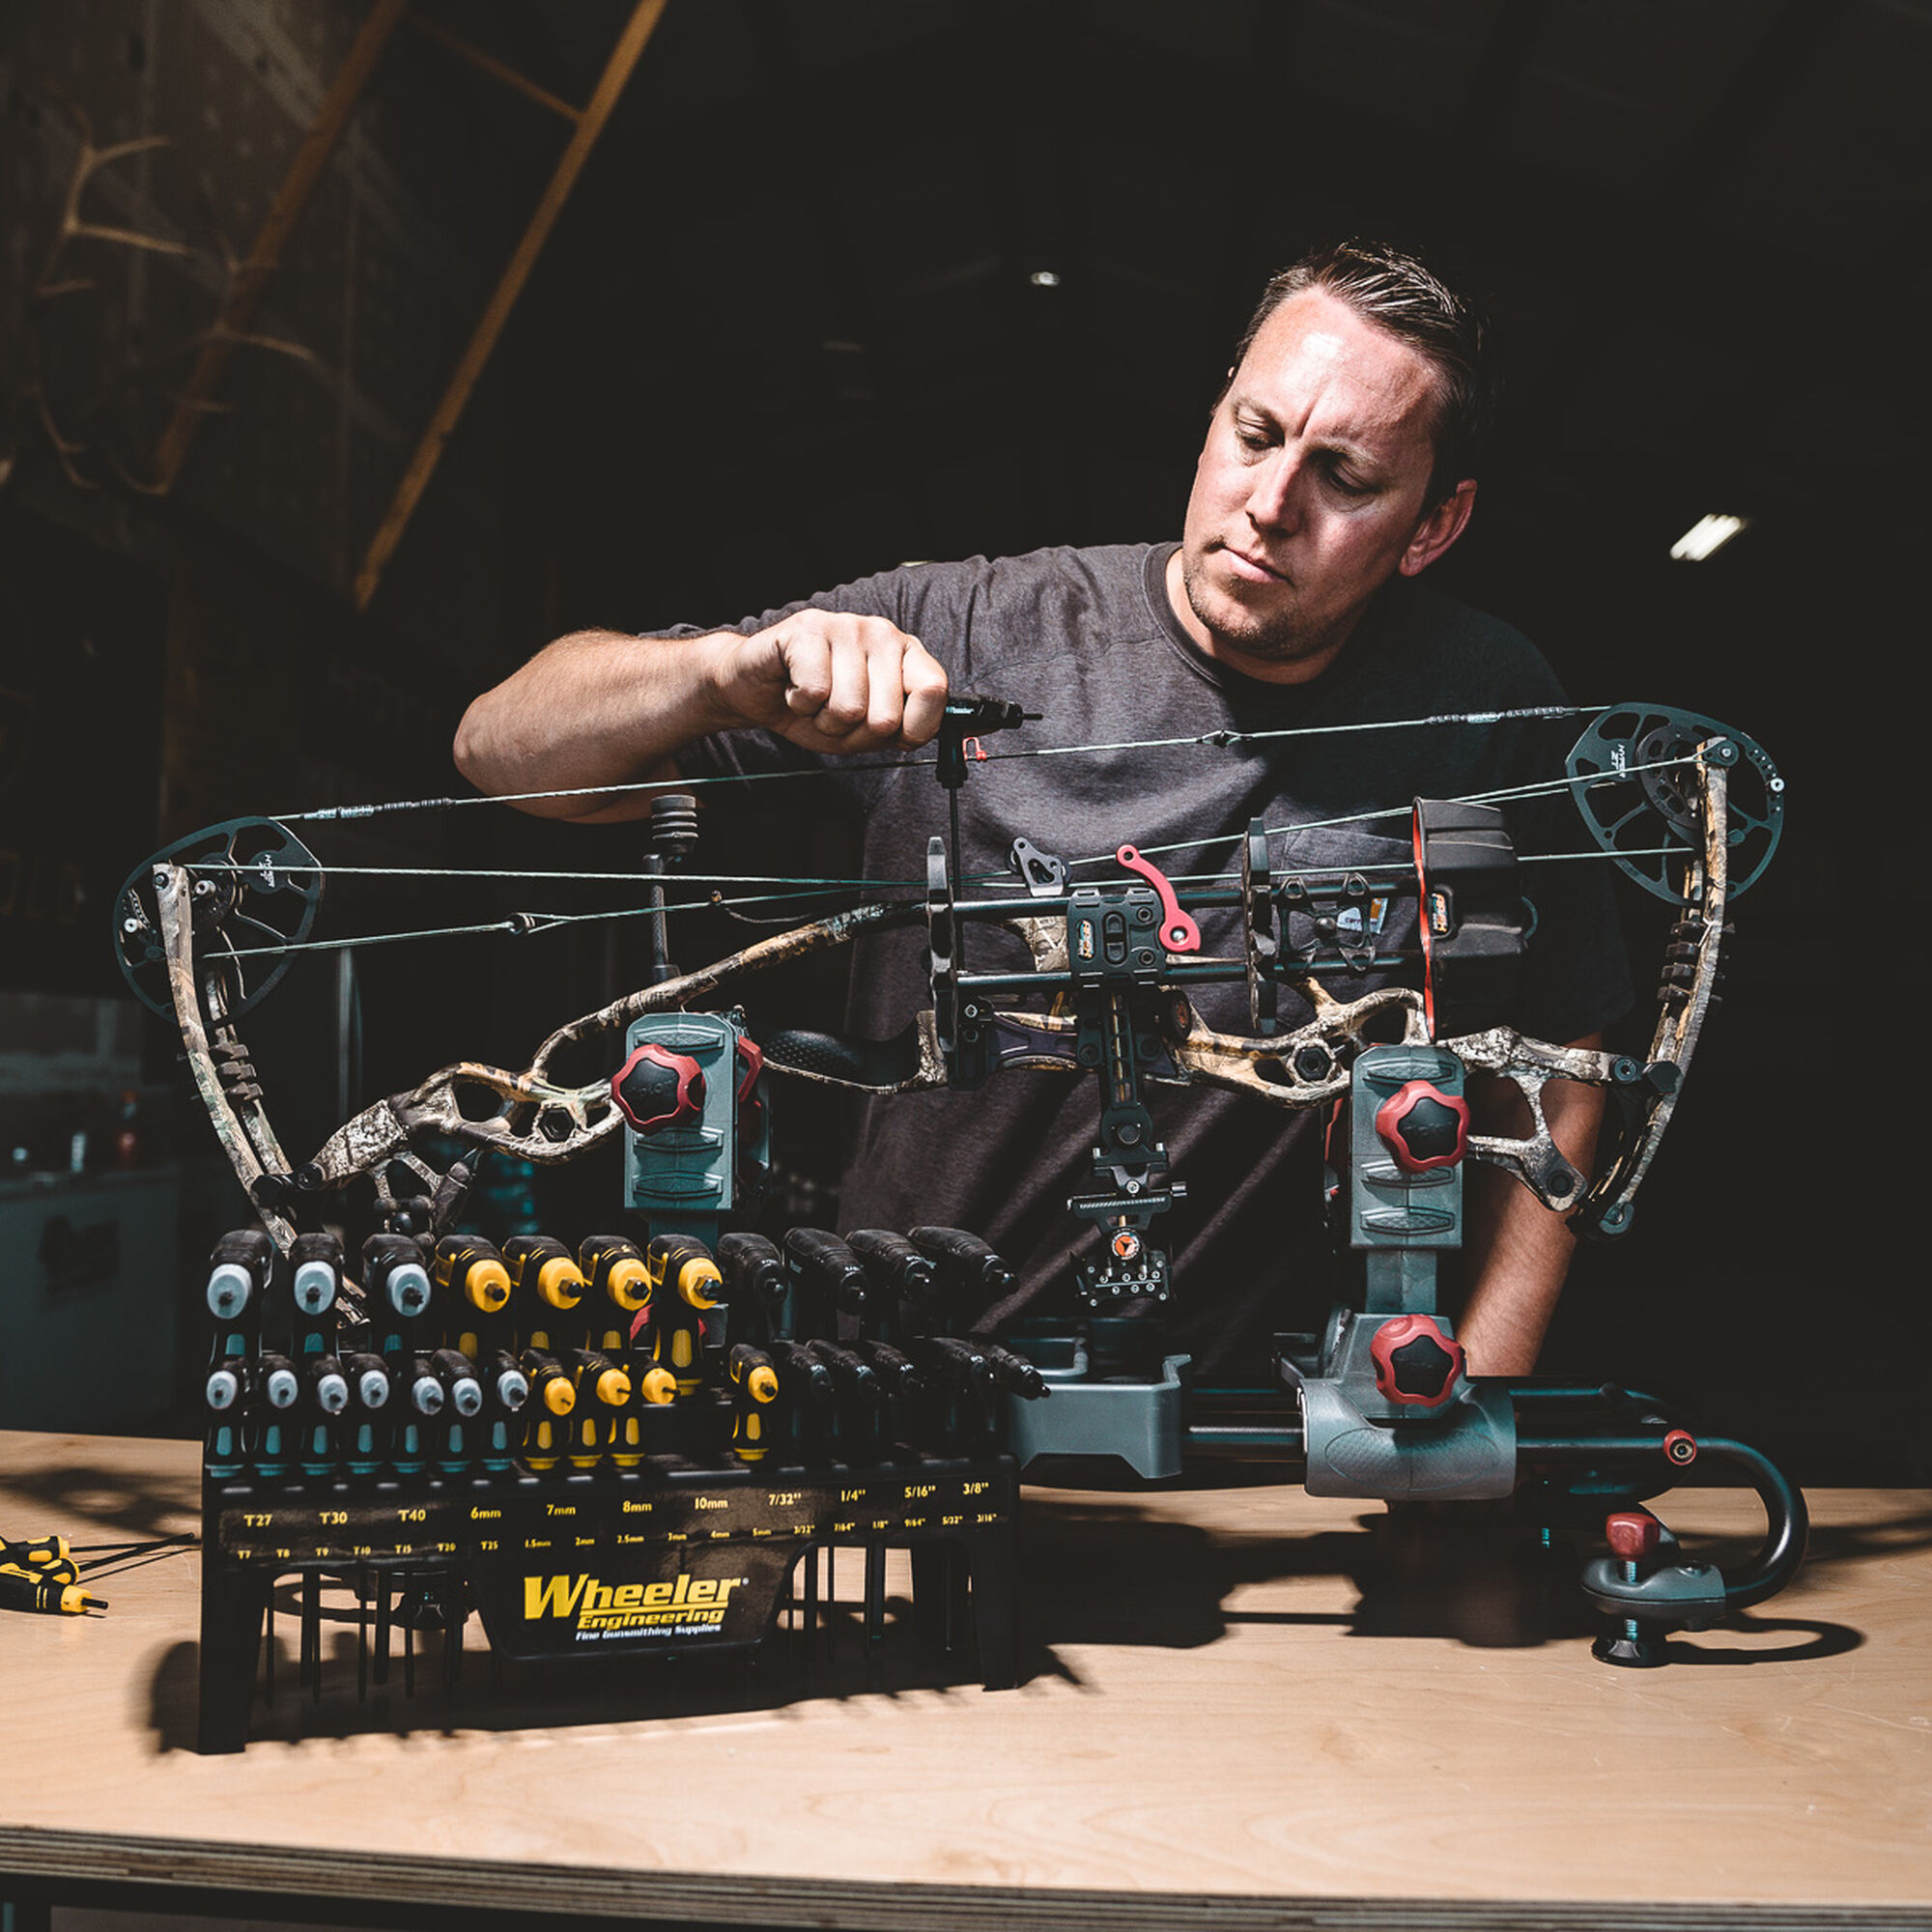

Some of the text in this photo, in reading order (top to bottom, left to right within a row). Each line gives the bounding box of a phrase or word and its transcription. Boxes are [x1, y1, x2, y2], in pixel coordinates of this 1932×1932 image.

[242, 1514, 273, 1527] T27
[319, 1511, 349, 1525] T30
[397, 1509, 426, 1522] T40
[470, 1506, 502, 1520] 6mm
[546, 1503, 577, 1516] 7mm
[622, 1500, 653, 1514] 8mm
[695, 1496, 729, 1511] 10mm
[237, 1549, 251, 1560] T7
[275, 1548, 291, 1558] T8
[315, 1547, 329, 1557] T9
[353, 1546, 372, 1556] T10
[394, 1544, 412, 1554] T15
[480, 1540, 498, 1550] T25
[617, 1534, 644, 1545] 2.5mm
[525, 1574, 741, 1619] Wheeler
[576, 1624, 722, 1640] Fine Gunsmithing Supplies
[577, 1609, 725, 1631] Engineering
